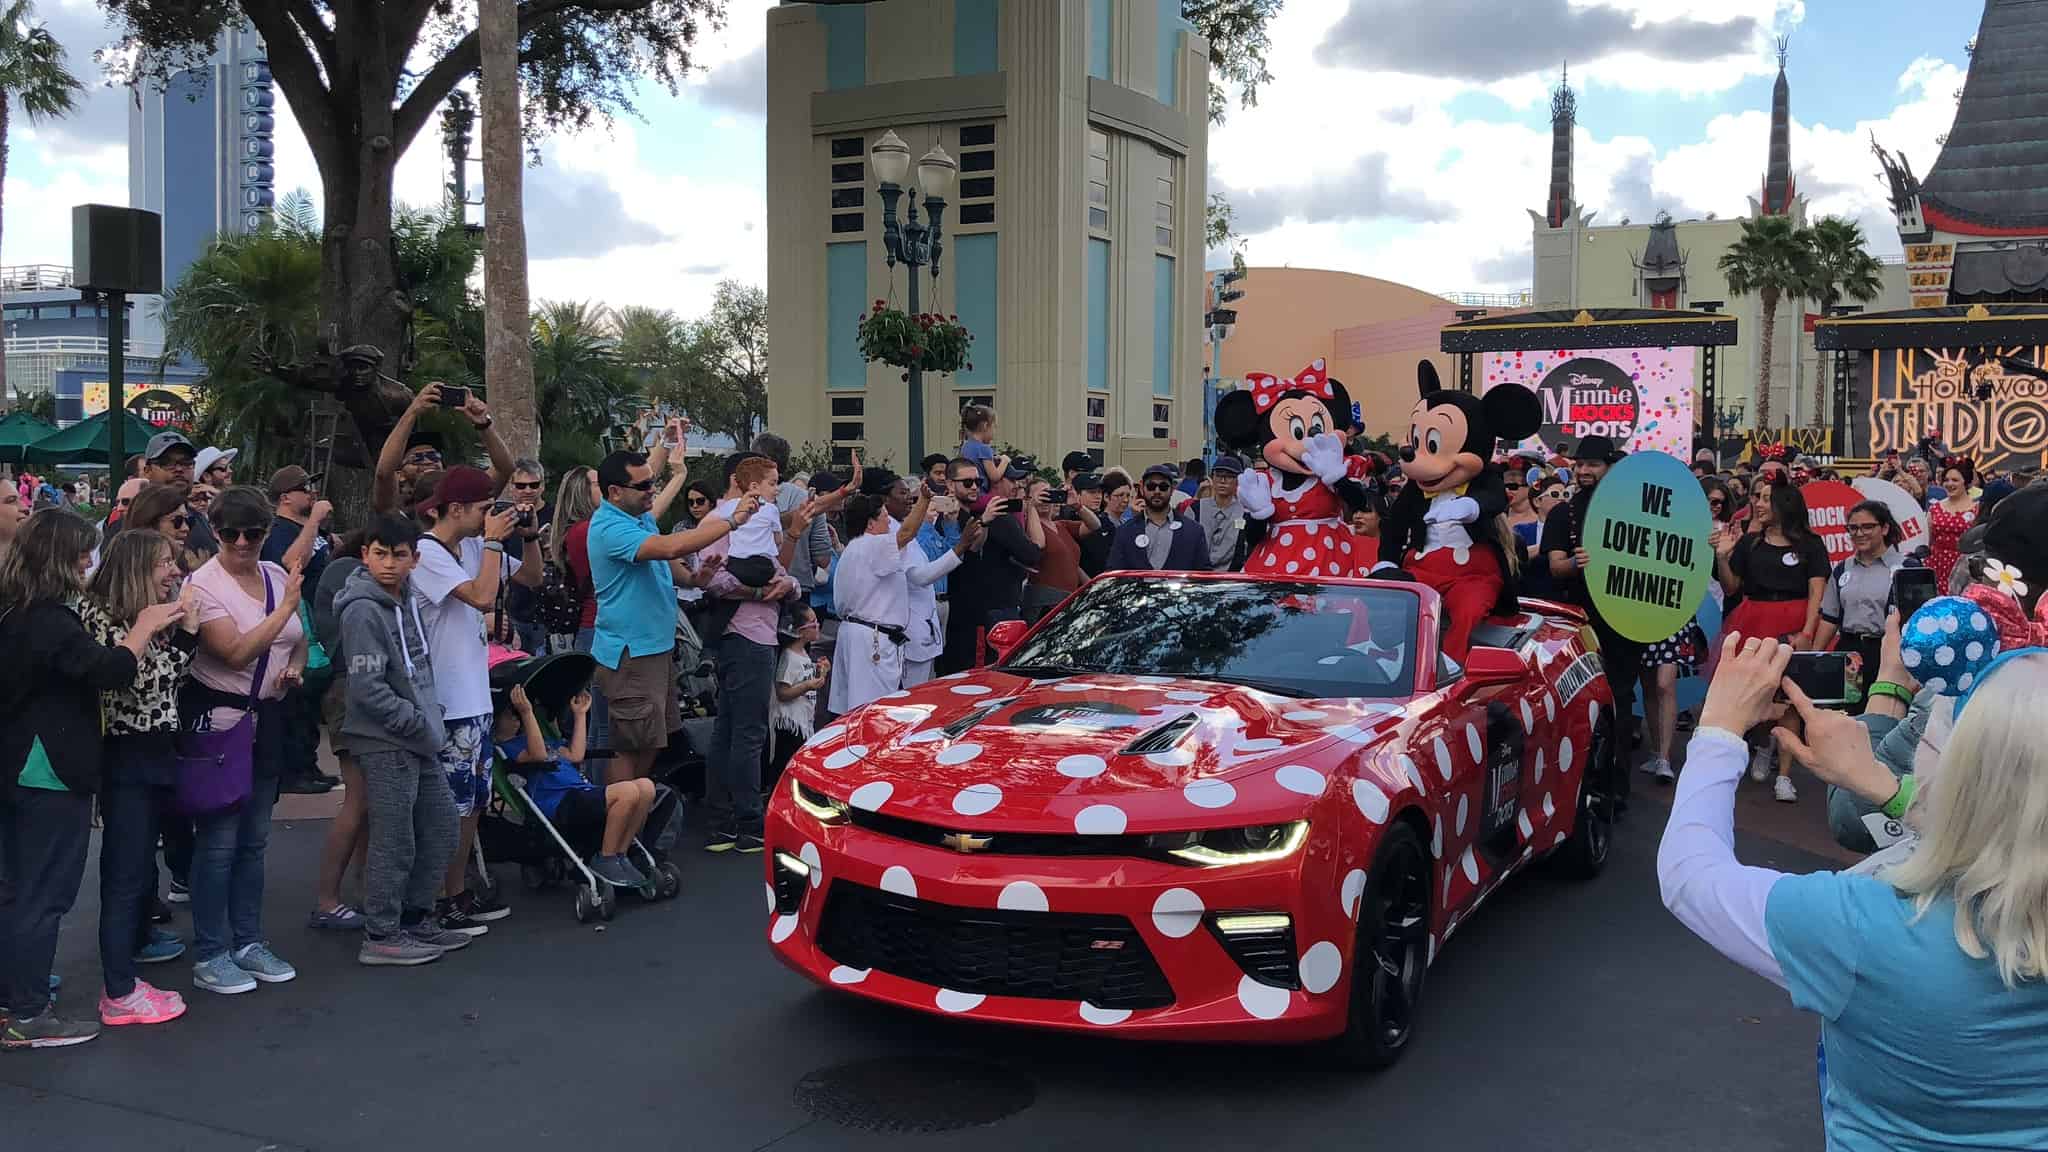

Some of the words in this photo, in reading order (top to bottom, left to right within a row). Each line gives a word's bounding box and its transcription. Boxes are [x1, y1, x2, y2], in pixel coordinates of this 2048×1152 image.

[1568, 373, 1605, 388] Disney
[1540, 386, 1633, 425] Minnie
[1570, 404, 1634, 421] ROCKS
[1575, 421, 1632, 438] DOTS
[1641, 482, 1673, 518] WE
[1602, 518, 1651, 558] LOVE
[1655, 530, 1695, 572] YOU,
[1822, 532, 1854, 553] OTS
[1605, 564, 1684, 610] MINNIE!
